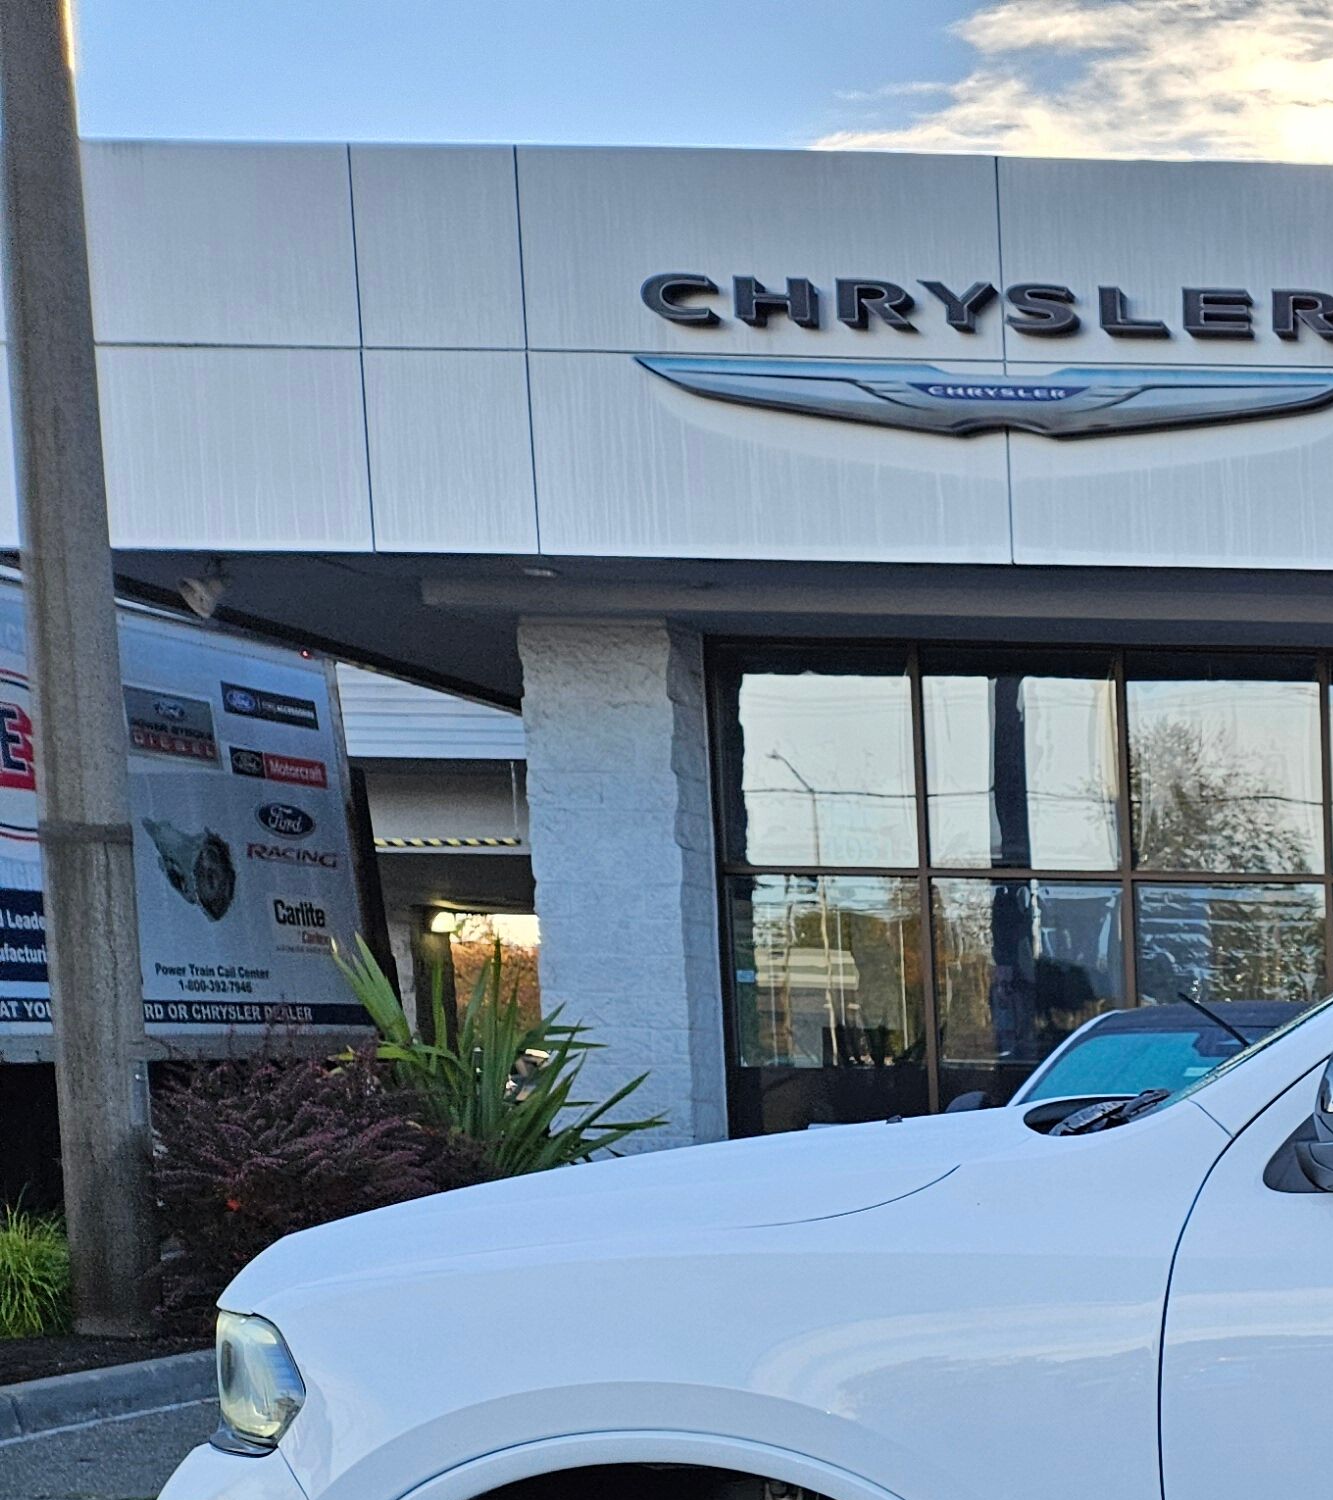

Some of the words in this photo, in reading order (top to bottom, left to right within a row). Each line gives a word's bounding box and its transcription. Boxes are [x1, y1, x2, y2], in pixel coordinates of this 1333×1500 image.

[927, 385, 1066, 399] CHRYSLER
[268, 760, 324, 781] Motorcraft
[267, 804, 305, 832] Ford
[247, 842, 338, 869] RACING
[273, 899, 326, 928] Carlite
[155, 963, 186, 976] Power
[189, 963, 216, 978] Train
[238, 966, 269, 979] Center
[168, 1003, 189, 1020] OR
[192, 1005, 260, 1021] CHRYSLER
